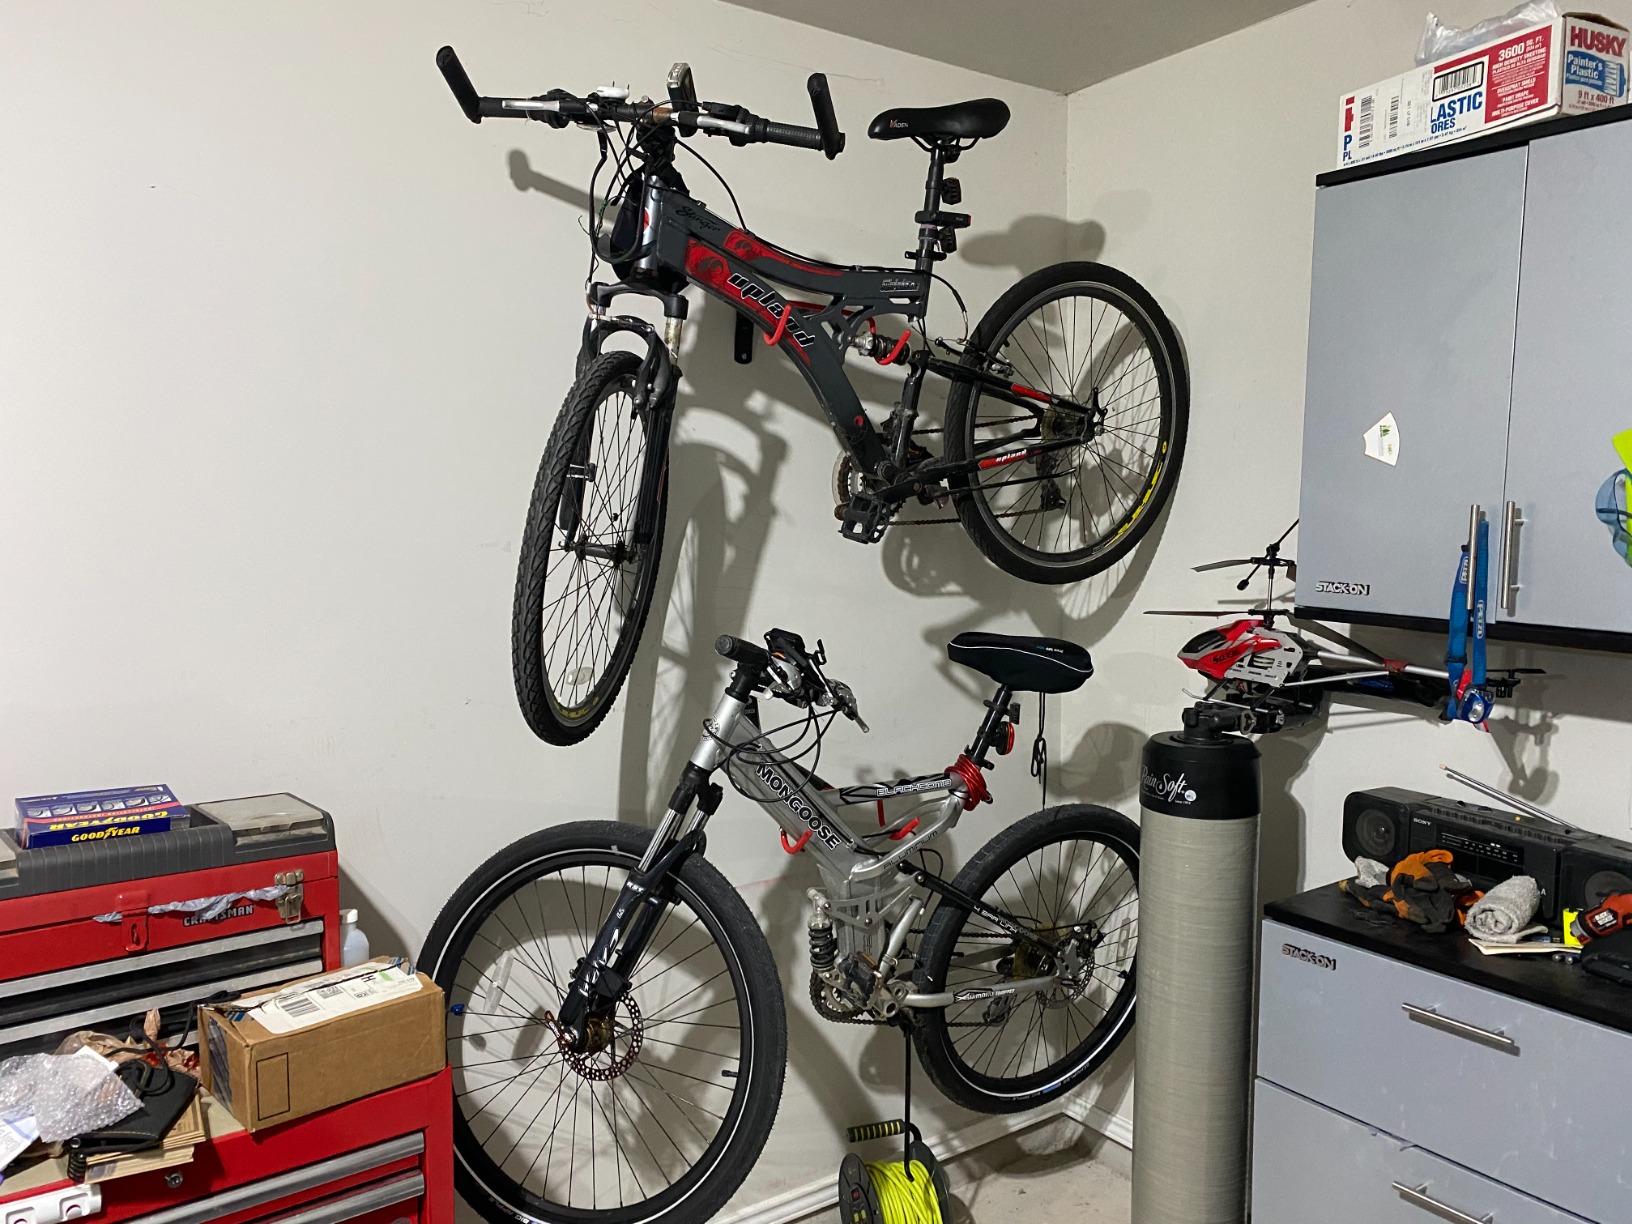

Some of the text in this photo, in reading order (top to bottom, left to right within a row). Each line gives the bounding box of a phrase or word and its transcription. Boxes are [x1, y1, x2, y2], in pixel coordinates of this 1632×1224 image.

[1570, 26, 1627, 57] HUSKY
[1498, 42, 1525, 61] 3600
[1567, 53, 1603, 71] Painter's
[1570, 64, 1599, 80] Plastic
[1577, 90, 1583, 99] 9
[1583, 91, 1590, 100] ft
[1595, 93, 1608, 104] 400
[1431, 117, 1456, 134] ORES
[876, 778, 952, 797] BLACKCOMB
[755, 760, 842, 850] MONGOOSE
[1413, 817, 1431, 826] SONY
[71, 826, 141, 843] GOODYEAR
[883, 830, 939, 870] ALUMINUM
